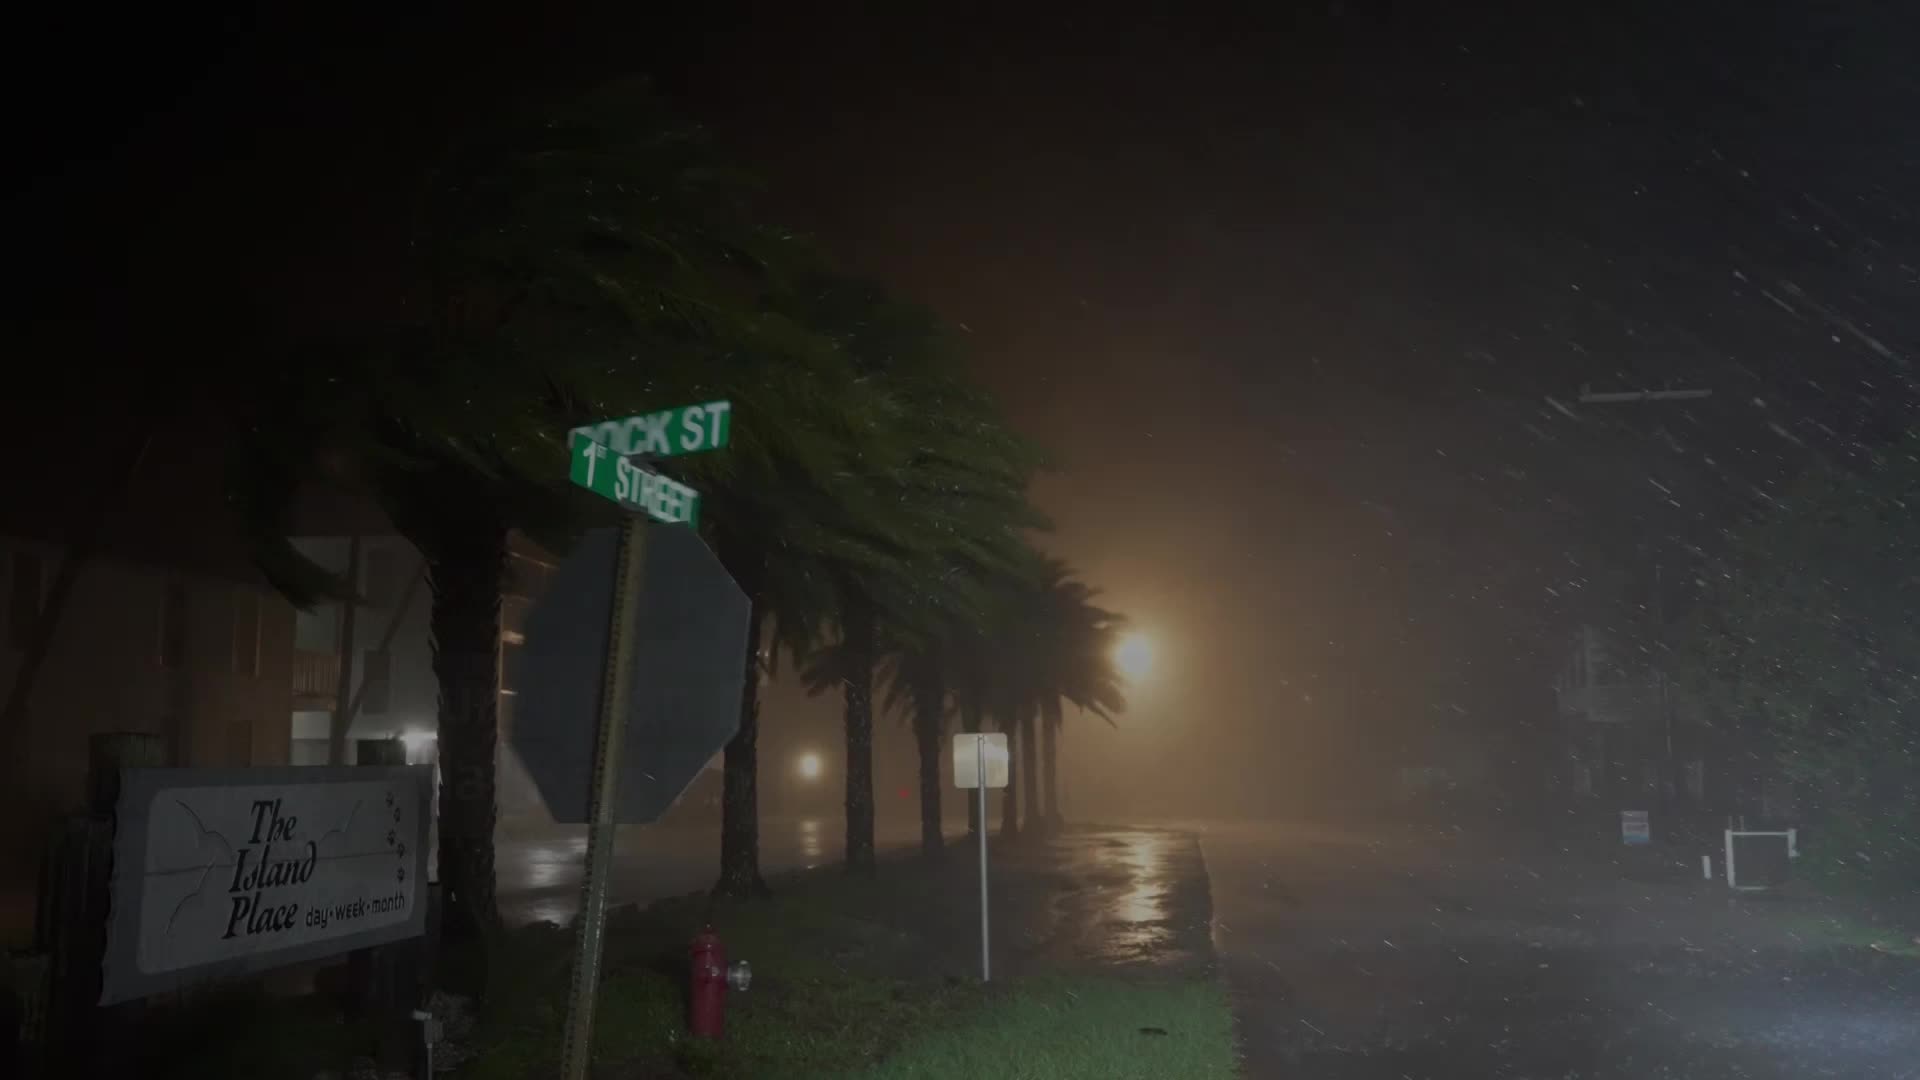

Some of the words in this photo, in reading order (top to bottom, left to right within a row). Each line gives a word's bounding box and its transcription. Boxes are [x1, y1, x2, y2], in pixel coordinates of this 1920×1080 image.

[680, 400, 732, 451] ST
[614, 455, 701, 524] STREET
[248, 797, 298, 845] The
[228, 840, 317, 893] Island
[221, 892, 298, 940] Place
